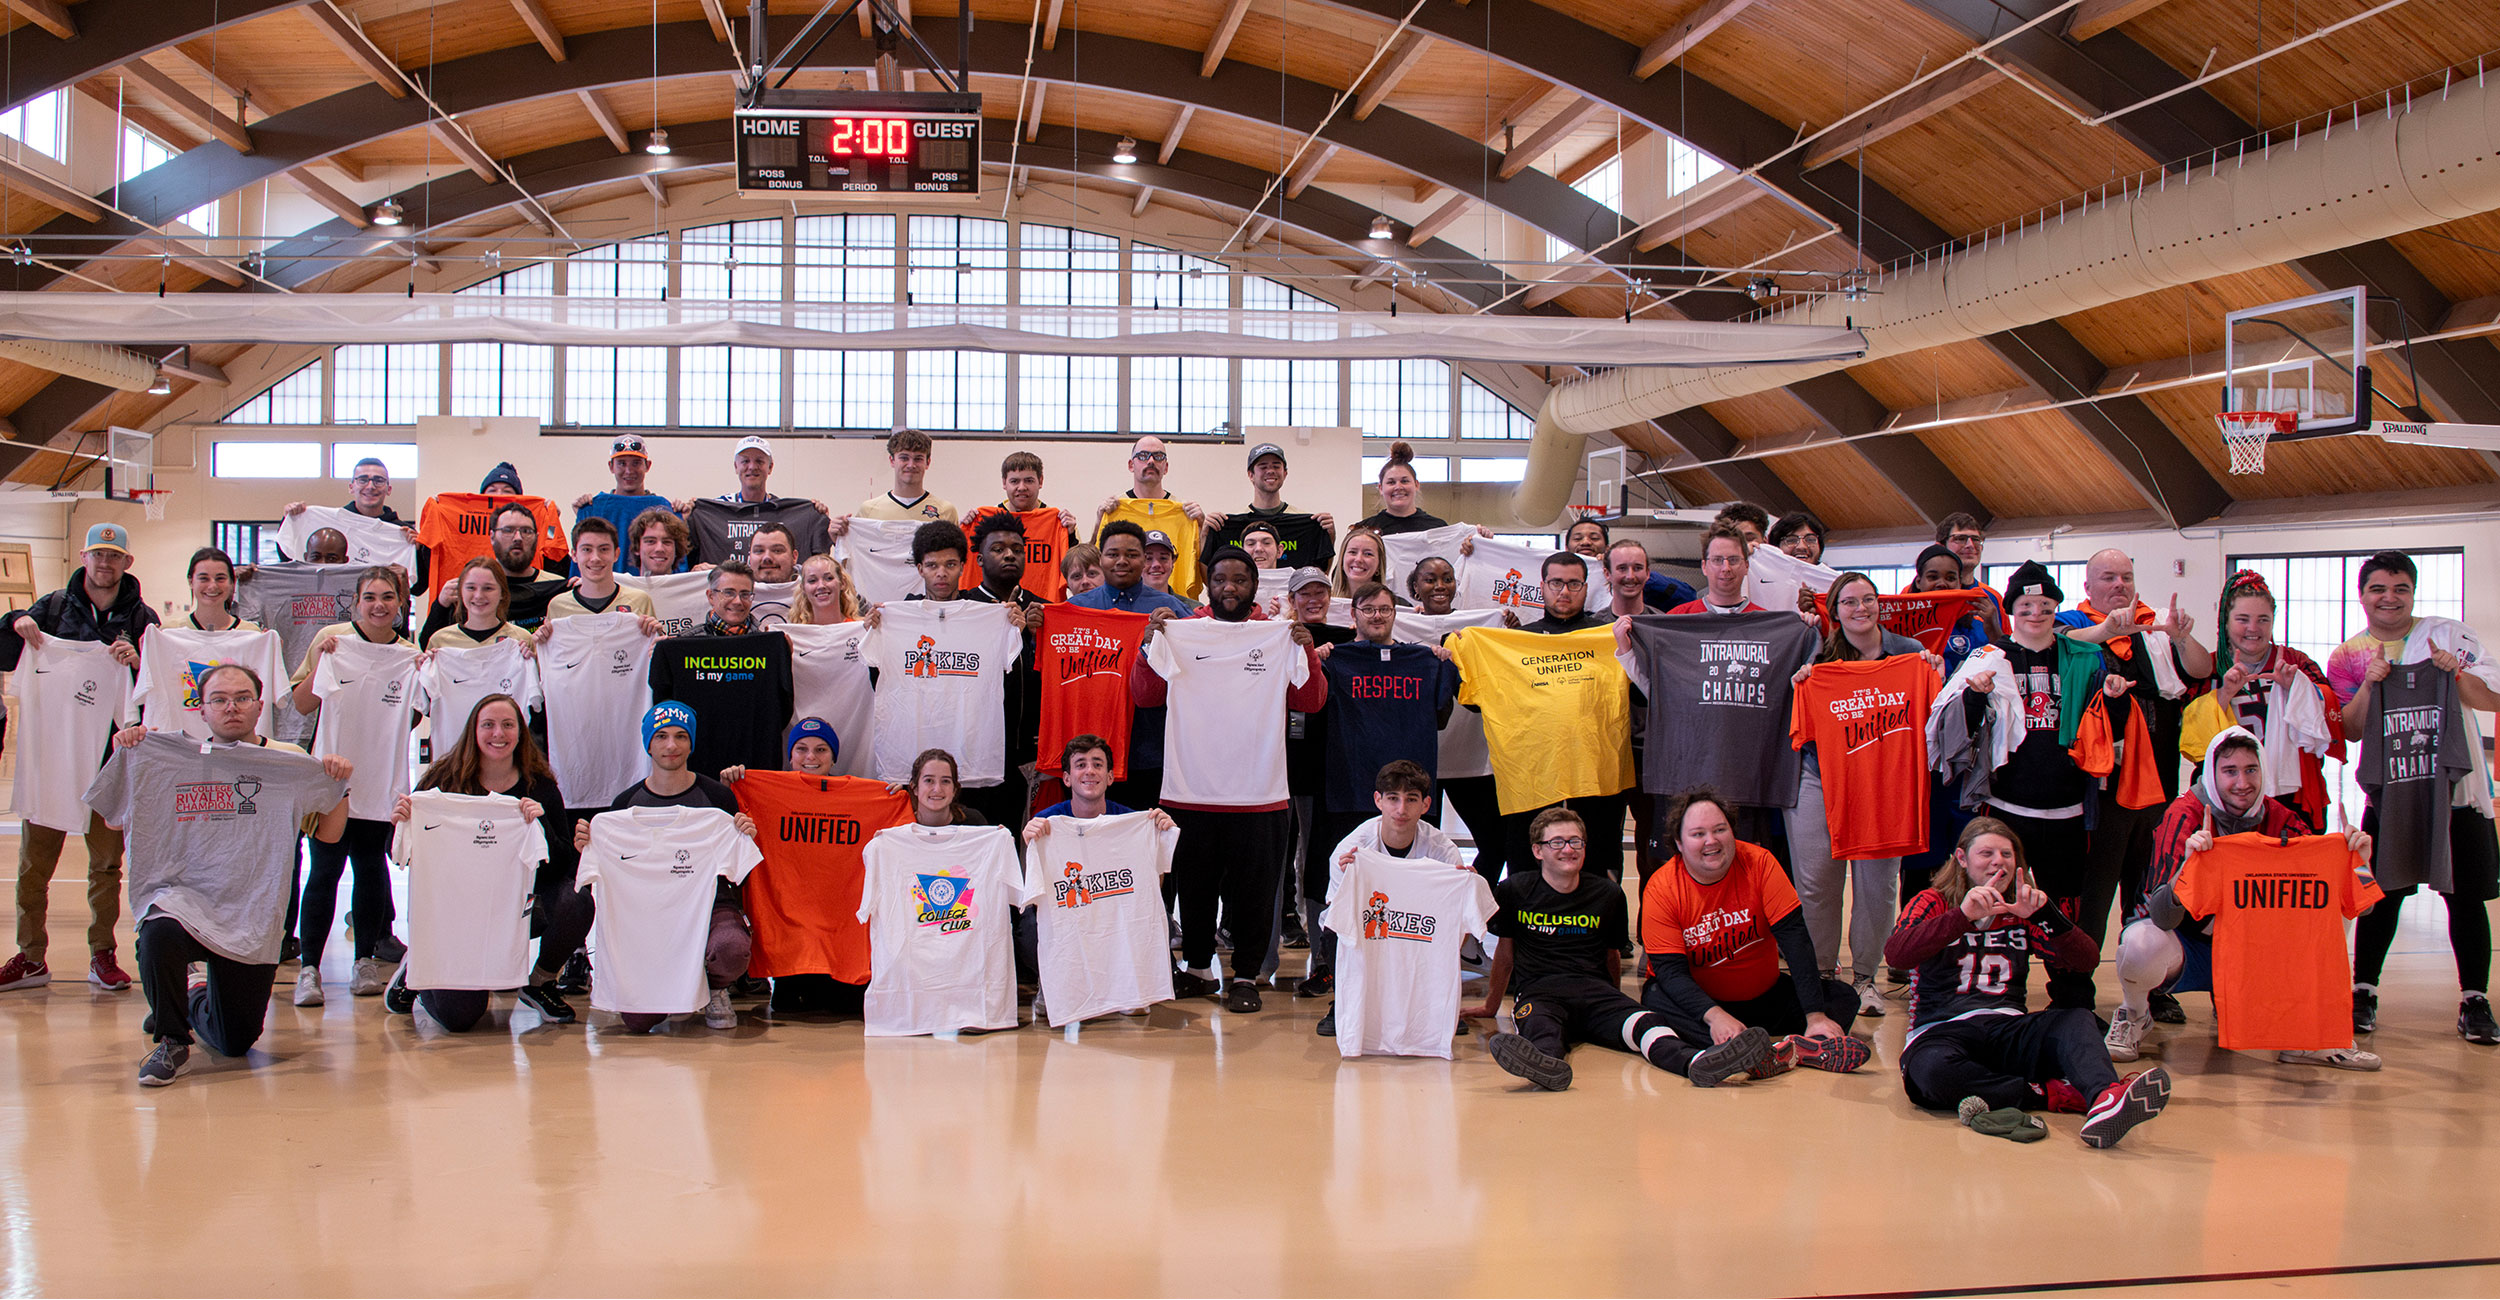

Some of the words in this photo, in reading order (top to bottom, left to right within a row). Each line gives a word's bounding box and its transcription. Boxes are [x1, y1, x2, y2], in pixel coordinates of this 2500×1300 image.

[743, 119, 800, 136] HOME
[913, 122, 976, 138] GUEST
[832, 118, 909, 155] 2:00
[808, 155, 829, 163] T.O.L.
[888, 156, 909, 164] T.O.L.
[759, 169, 785, 178] POSS
[932, 172, 958, 181] POSS
[768, 180, 803, 189] BONUS
[842, 183, 878, 192] PERIOD
[914, 182, 949, 191] BONUS
[2382, 422, 2428, 435] SPALDING
[292, 602, 336, 611] RIVALRY
[1907, 600, 1933, 611] DAY
[1073, 627, 1091, 635] IT'S
[1050, 633, 1093, 646] GREAT
[1094, 636, 1122, 651] DAY
[1521, 649, 1595, 666] GENERATION
[1700, 644, 1770, 665] INTRAMURAL
[684, 656, 767, 670] INCLUSION
[1060, 647, 1124, 680] Unified
[1537, 662, 1583, 675] UNIFIED
[696, 670, 705, 680] is
[707, 672, 723, 682] my
[725, 672, 755, 682] game
[1708, 665, 1719, 676] 20
[1750, 667, 1760, 678] 23
[1351, 675, 1424, 700] RESPECT
[1702, 680, 1766, 704] CHAMPS
[1852, 688, 1871, 697] IT'S
[1874, 687, 1880, 695] A
[1829, 695, 1875, 713] GREAT
[1878, 692, 1906, 707] DAY
[1836, 713, 1849, 721] TO
[1851, 711, 1864, 719] BE
[1845, 699, 1910, 748] Unified
[2026, 717, 2055, 729] UTAH
[192, 785, 233, 793] COLLEGE
[176, 791, 234, 804] RIVALRY
[175, 801, 234, 812] CHAMPION
[780, 816, 861, 845] UNIFIED
[2233, 879, 2329, 910] UNIFIED
[918, 908, 968, 923] COLLEGE
[1518, 910, 1600, 928] INCLUSION
[941, 919, 971, 932] CLUB
[1538, 925, 1556, 935] my
[1683, 917, 1720, 940] GREAT
[1723, 908, 1751, 927] DAY
[1692, 914, 1760, 968] Unified
[1699, 934, 1712, 945] BE
[1947, 928, 2028, 951] TES
[1956, 952, 2012, 995] 10
